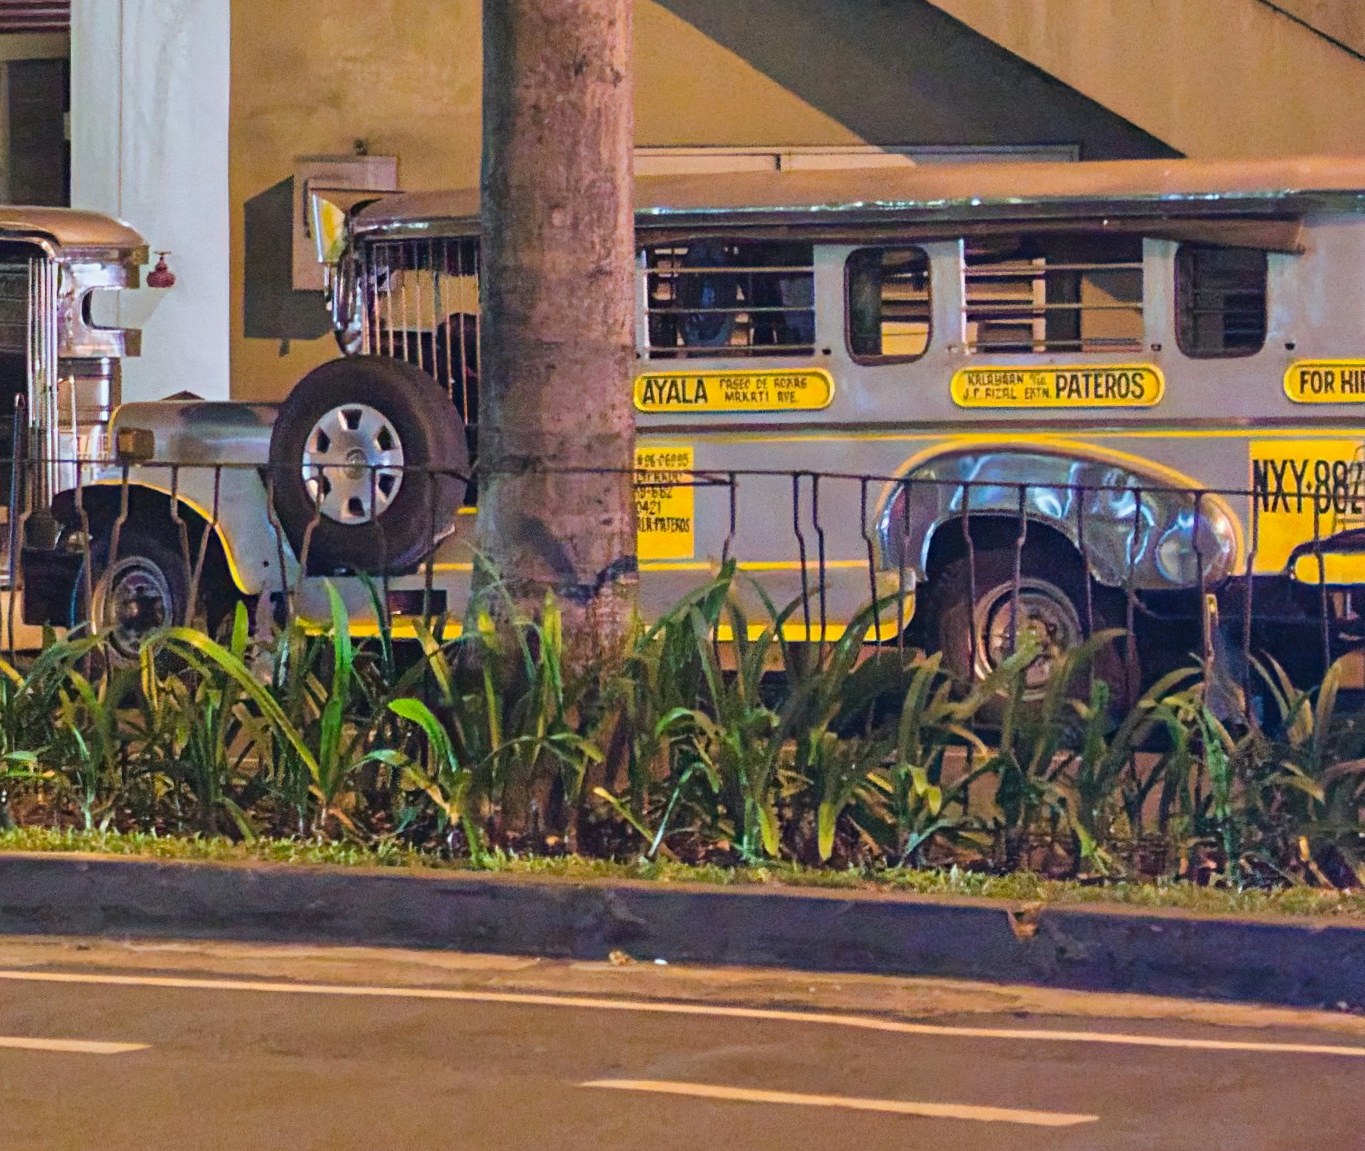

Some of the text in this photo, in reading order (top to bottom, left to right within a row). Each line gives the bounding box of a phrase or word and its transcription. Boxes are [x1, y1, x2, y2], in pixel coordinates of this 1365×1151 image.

[642, 378, 709, 405] AYALA
[1055, 372, 1145, 400] PATEROS
[1299, 370, 1335, 395] FOR
